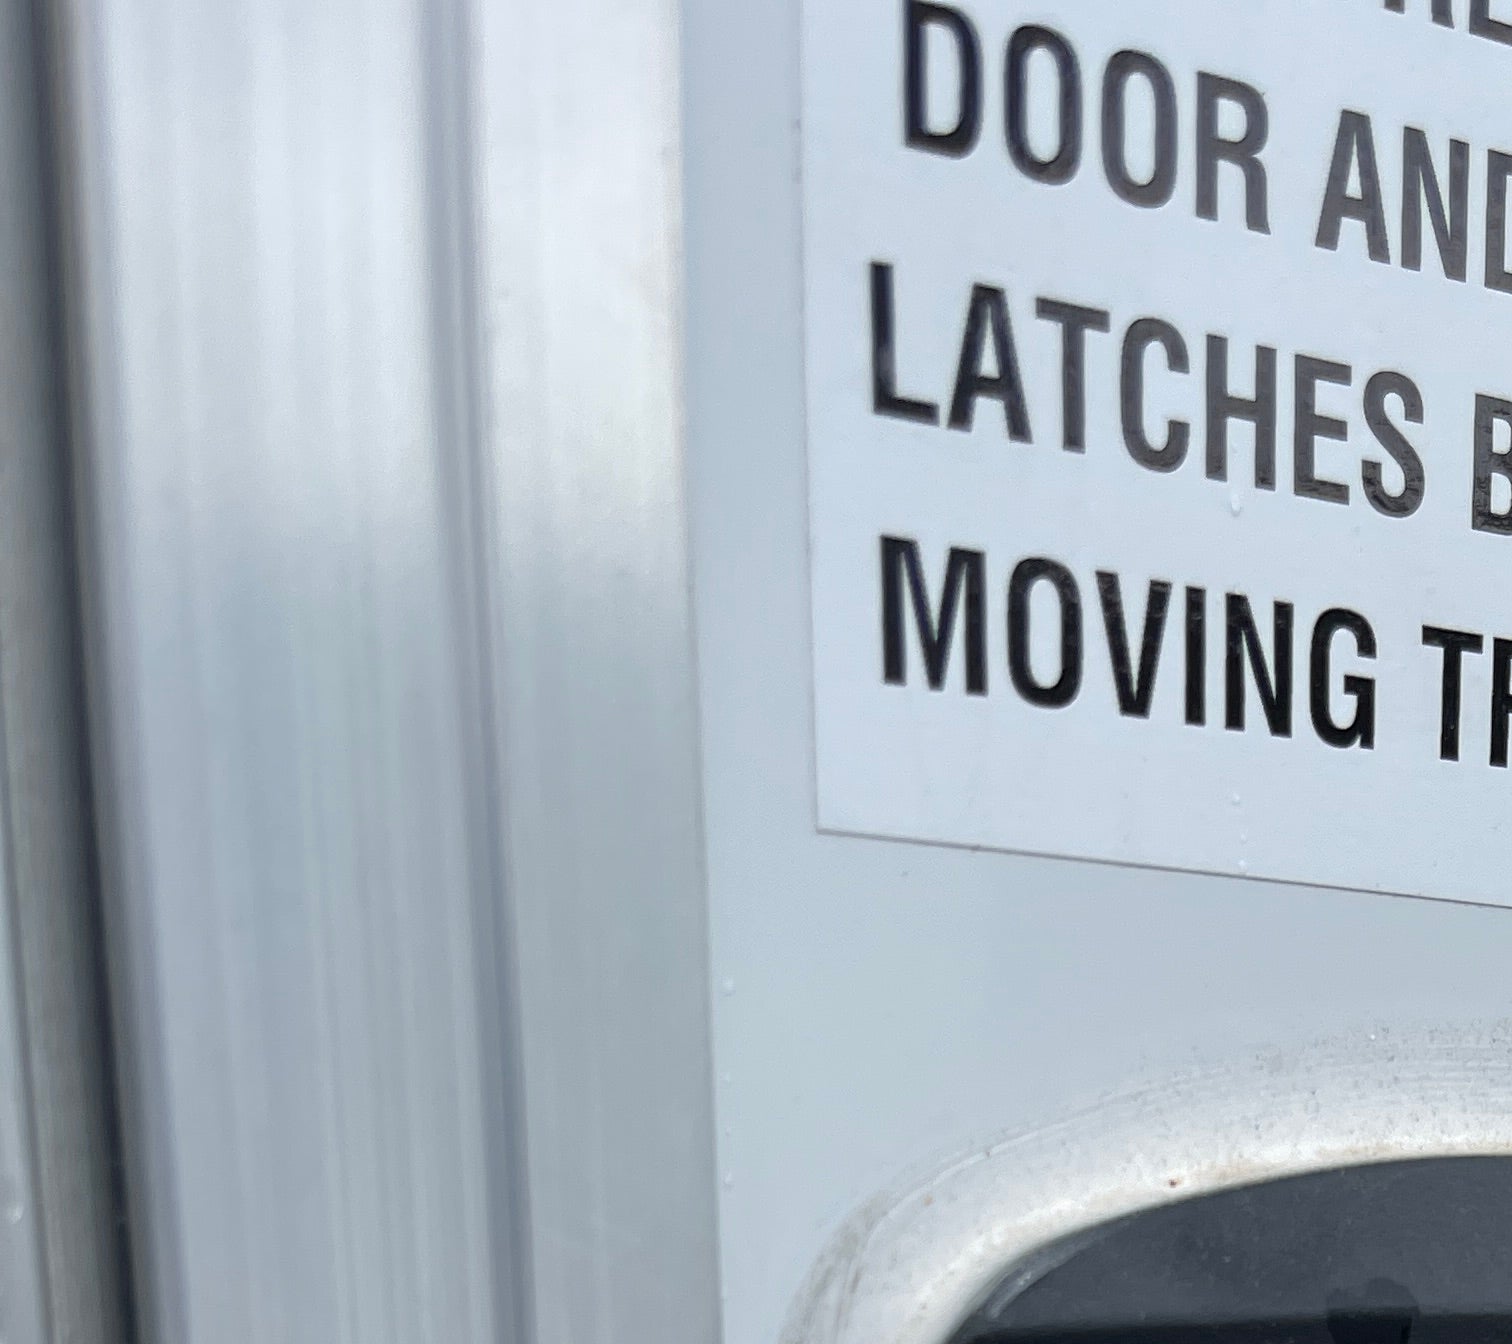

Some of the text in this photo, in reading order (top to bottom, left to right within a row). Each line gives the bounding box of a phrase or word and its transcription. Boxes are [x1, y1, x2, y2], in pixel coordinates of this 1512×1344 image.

[903, 0, 1270, 232] DOOR
[870, 261, 1425, 518] LATCHES
[880, 534, 1377, 750] MOVING
